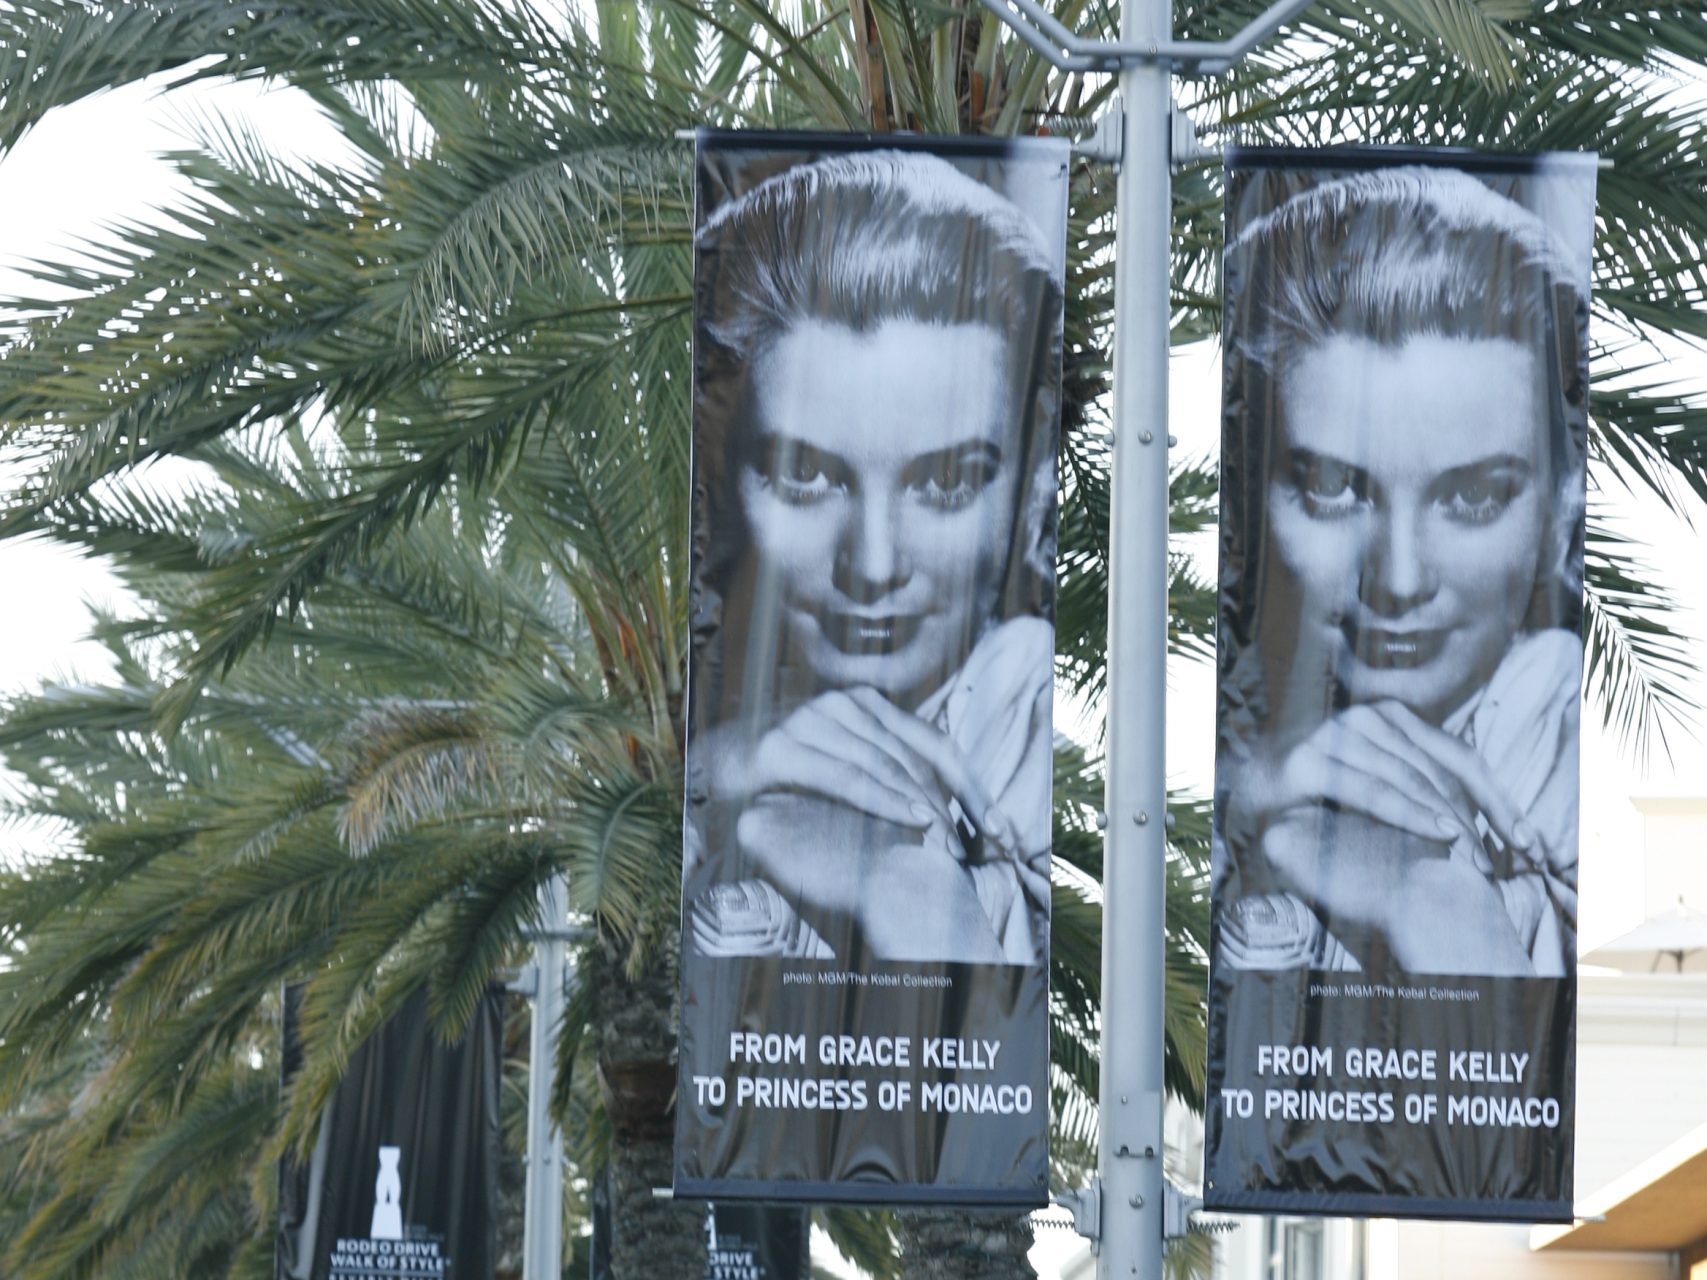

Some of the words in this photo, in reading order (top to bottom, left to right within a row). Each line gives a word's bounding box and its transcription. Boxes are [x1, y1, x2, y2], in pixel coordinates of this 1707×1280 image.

[870, 973, 901, 986] Kobal
[903, 973, 953, 987] Collection
[1397, 985, 1427, 1000] Kobal
[1429, 987, 1480, 1002] Collection
[730, 1032, 806, 1064] FROM
[819, 1035, 910, 1066] GRACE
[922, 1038, 1001, 1070] KELLY
[1257, 1045, 1332, 1077] FROM
[1345, 1047, 1437, 1081] GRACE
[1448, 1051, 1528, 1083] KELLY
[693, 1076, 726, 1106] TO
[737, 1077, 868, 1111] PRINCESS
[878, 1081, 911, 1111] OF
[921, 1082, 1033, 1115] MONACO
[1220, 1089, 1254, 1119] TO
[1264, 1090, 1394, 1124] PRINCESS
[1404, 1094, 1437, 1124] OF
[1446, 1095, 1559, 1128] MONACO
[330, 1254, 374, 1268] WALK
[376, 1256, 396, 1269] OF
[336, 1239, 391, 1255] RODEO
[393, 1242, 438, 1257] DRIVE
